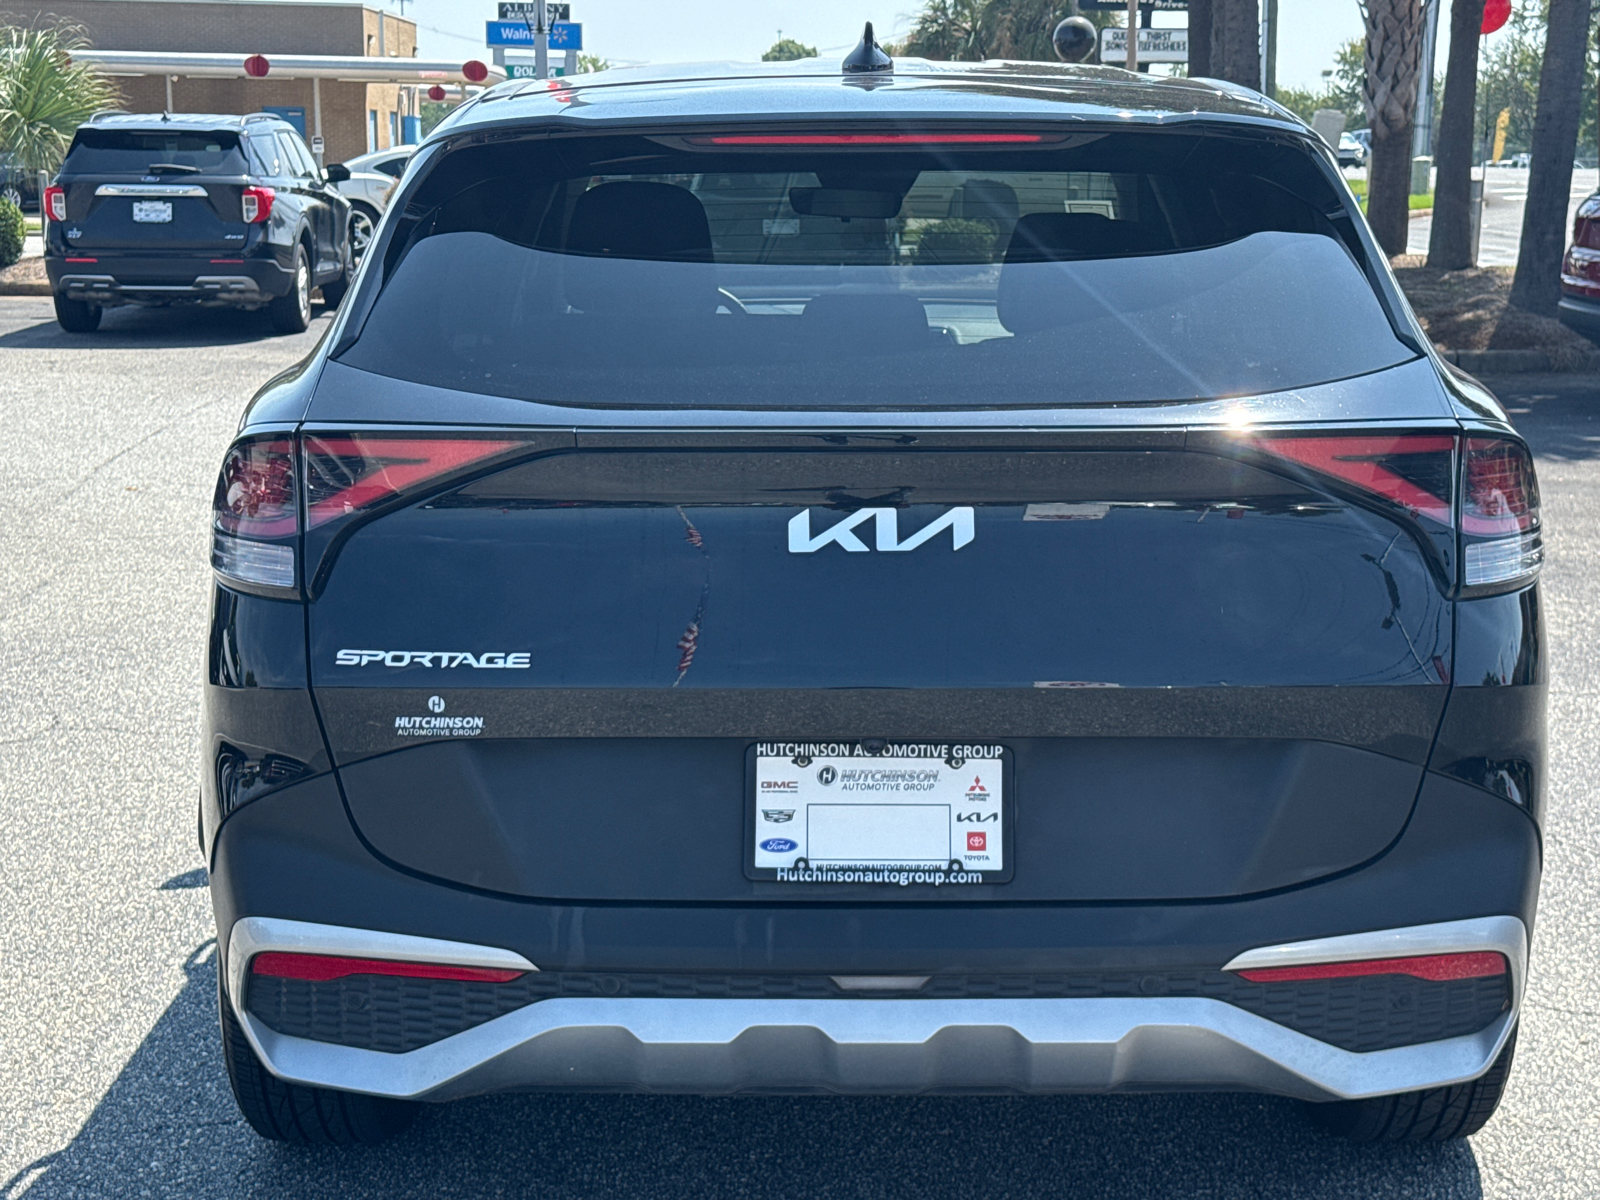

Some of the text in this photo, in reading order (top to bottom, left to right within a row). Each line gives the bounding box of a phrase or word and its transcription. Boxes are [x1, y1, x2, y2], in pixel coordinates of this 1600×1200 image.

[502, 3, 565, 12] ALBNY
[501, 27, 551, 40] Walm
[513, 65, 557, 78] DOLR
[788, 506, 975, 553] KIA
[336, 649, 532, 669] SPORTAGE
[395, 716, 485, 728] HUTCHINSON
[397, 728, 450, 736] AUTOMOTIVE
[756, 743, 1004, 759] HUTCHINSON AOMOTIVE GROUP
[840, 769, 941, 783] HUTCHINSON
[761, 781, 798, 789] GMC
[841, 782, 935, 791] AUTOMOTIVE GROUP
[957, 812, 998, 823] KIA
[767, 840, 791, 850] Ford
[777, 867, 983, 886] Hutchinsonautogroup.com
